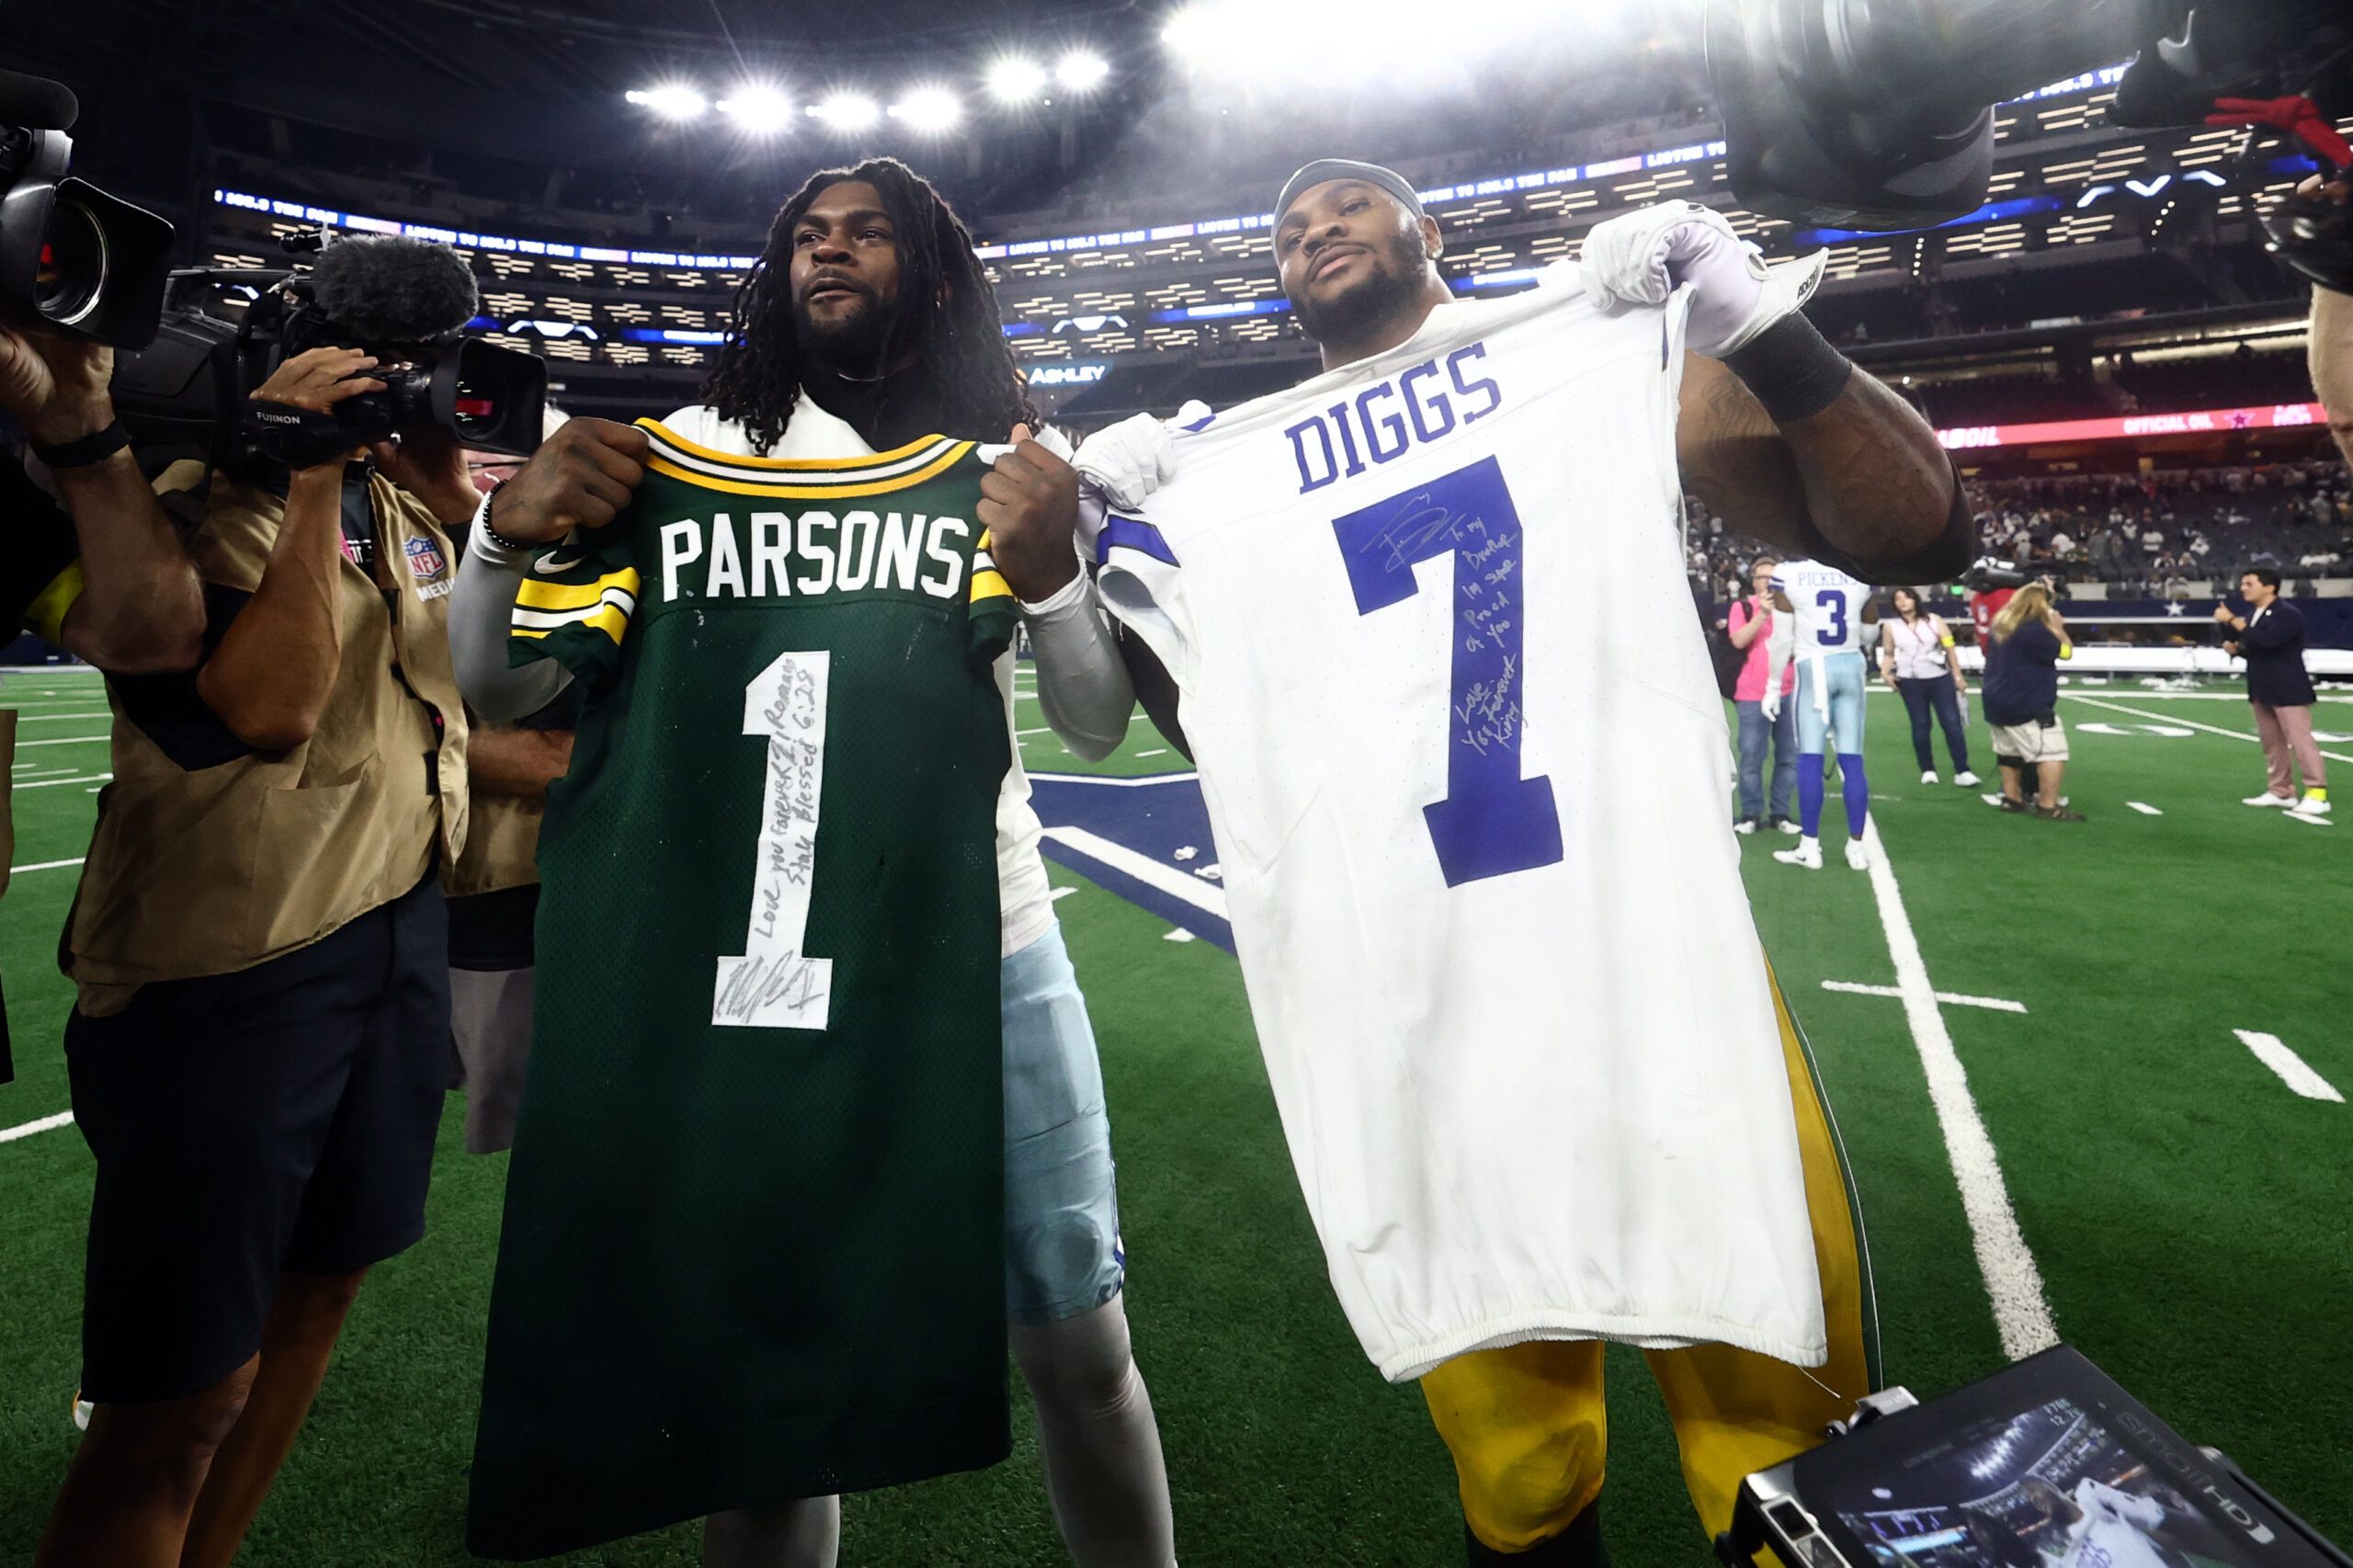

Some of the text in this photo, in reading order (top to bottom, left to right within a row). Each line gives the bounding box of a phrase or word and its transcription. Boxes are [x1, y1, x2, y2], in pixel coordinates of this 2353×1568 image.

[1029, 366, 1106, 385] ASHLEY
[256, 411, 301, 425] FUJINON
[1284, 341, 1502, 494] DIGGS
[2123, 413, 2215, 435] OFFICIAL OIL
[410, 552, 442, 574] NFL
[660, 510, 970, 602] PARSONS
[1816, 590, 1847, 645] 3
[1332, 454, 1563, 888] 7
[711, 650, 833, 1030] 1
